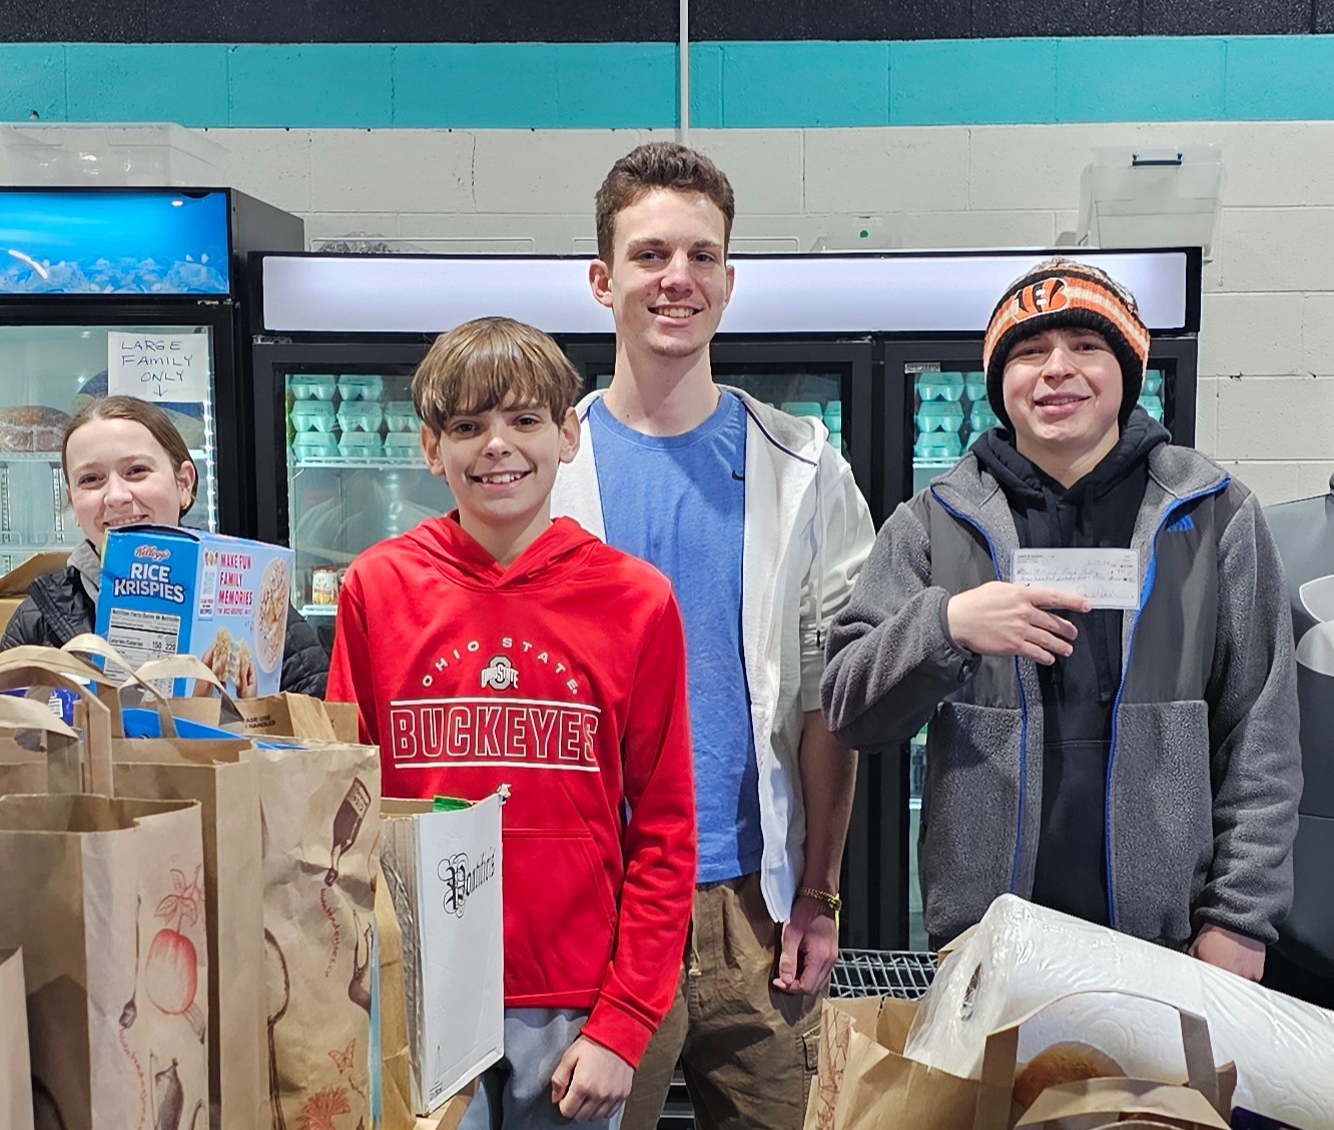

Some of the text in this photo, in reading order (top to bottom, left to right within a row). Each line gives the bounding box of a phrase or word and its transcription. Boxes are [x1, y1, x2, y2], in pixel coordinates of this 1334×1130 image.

[121, 340, 183, 352] LARGE
[121, 354, 193, 366] FAMILY
[140, 370, 184, 382] ONLY
[220, 553, 251, 569] MAKE FUN
[130, 562, 171, 583] RICE
[219, 571, 242, 587] FAMILY
[113, 579, 184, 604] KRISPIES
[218, 590, 253, 605] MEMORIES
[422, 637, 579, 692] OHIO STATE
[390, 706, 599, 762] BUCKEYES
